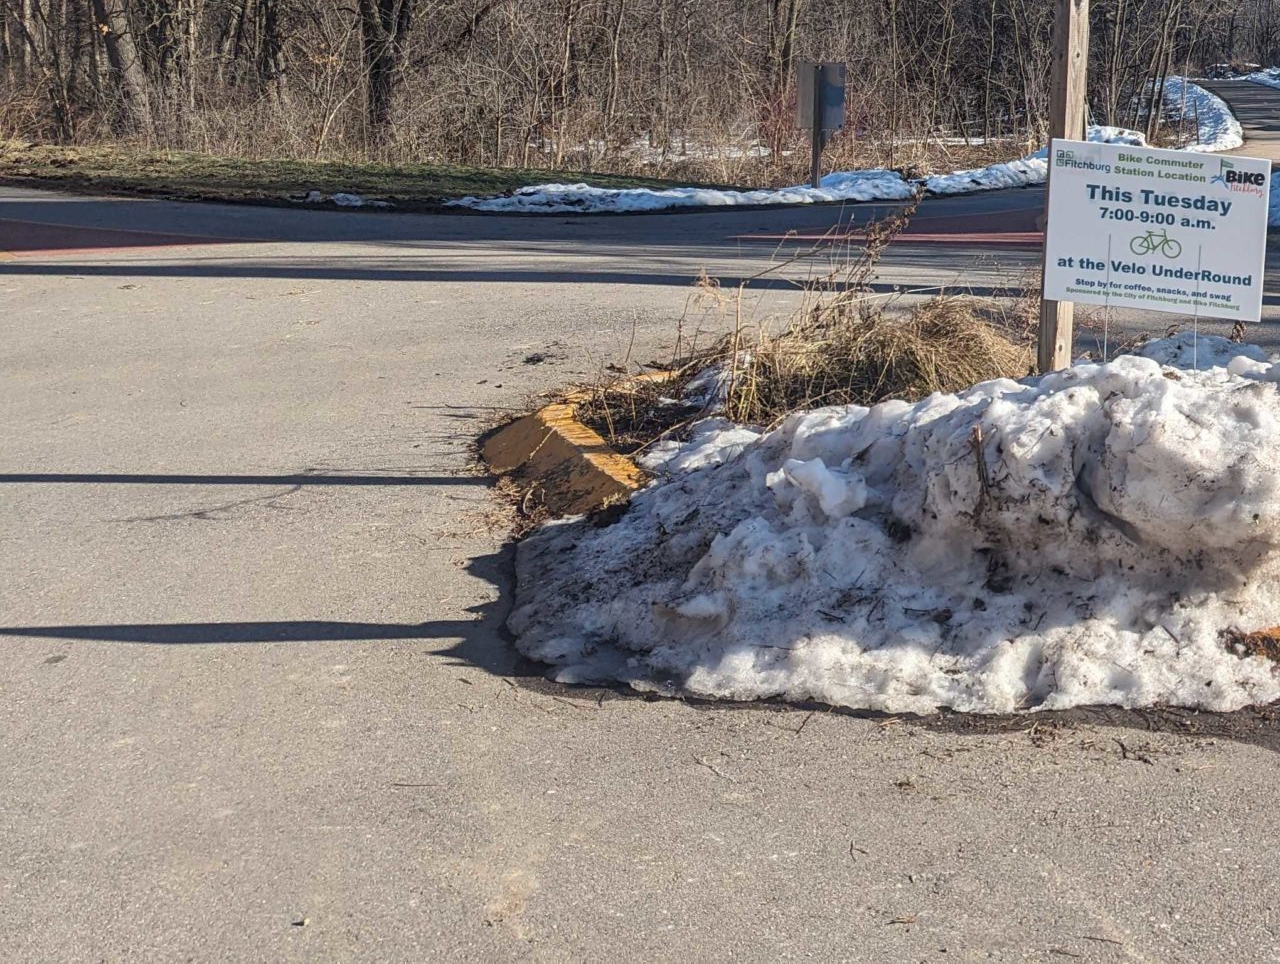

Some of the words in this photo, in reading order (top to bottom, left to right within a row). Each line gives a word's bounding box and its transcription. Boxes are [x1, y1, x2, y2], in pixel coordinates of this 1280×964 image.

[1065, 159, 1111, 174] Fitchburg
[1118, 153, 1142, 164] Bike
[1146, 156, 1204, 170] Commuter
[1114, 166, 1154, 178] Station
[1158, 170, 1206, 183] Location
[1226, 170, 1265, 186] Bike
[1086, 184, 1133, 203] This
[1140, 189, 1232, 216] Tuesday
[1100, 207, 1175, 225] 7:00-9:00
[1180, 217, 1216, 230] a.m.
[1057, 257, 1073, 267] at
[1079, 258, 1105, 270] the
[1111, 260, 1145, 275] Velo
[1152, 265, 1252, 286] UnderRound
[1066, 287, 1100, 295] Sponsored
[1147, 294, 1178, 304] Fitchburg
[1209, 301, 1240, 311] Fitchburg
[1076, 278, 1095, 287] Stop
[1098, 281, 1108, 289] by
[1124, 283, 1154, 293] coffee,
[1157, 287, 1189, 296] snacks,
[1210, 294, 1231, 302] swag
